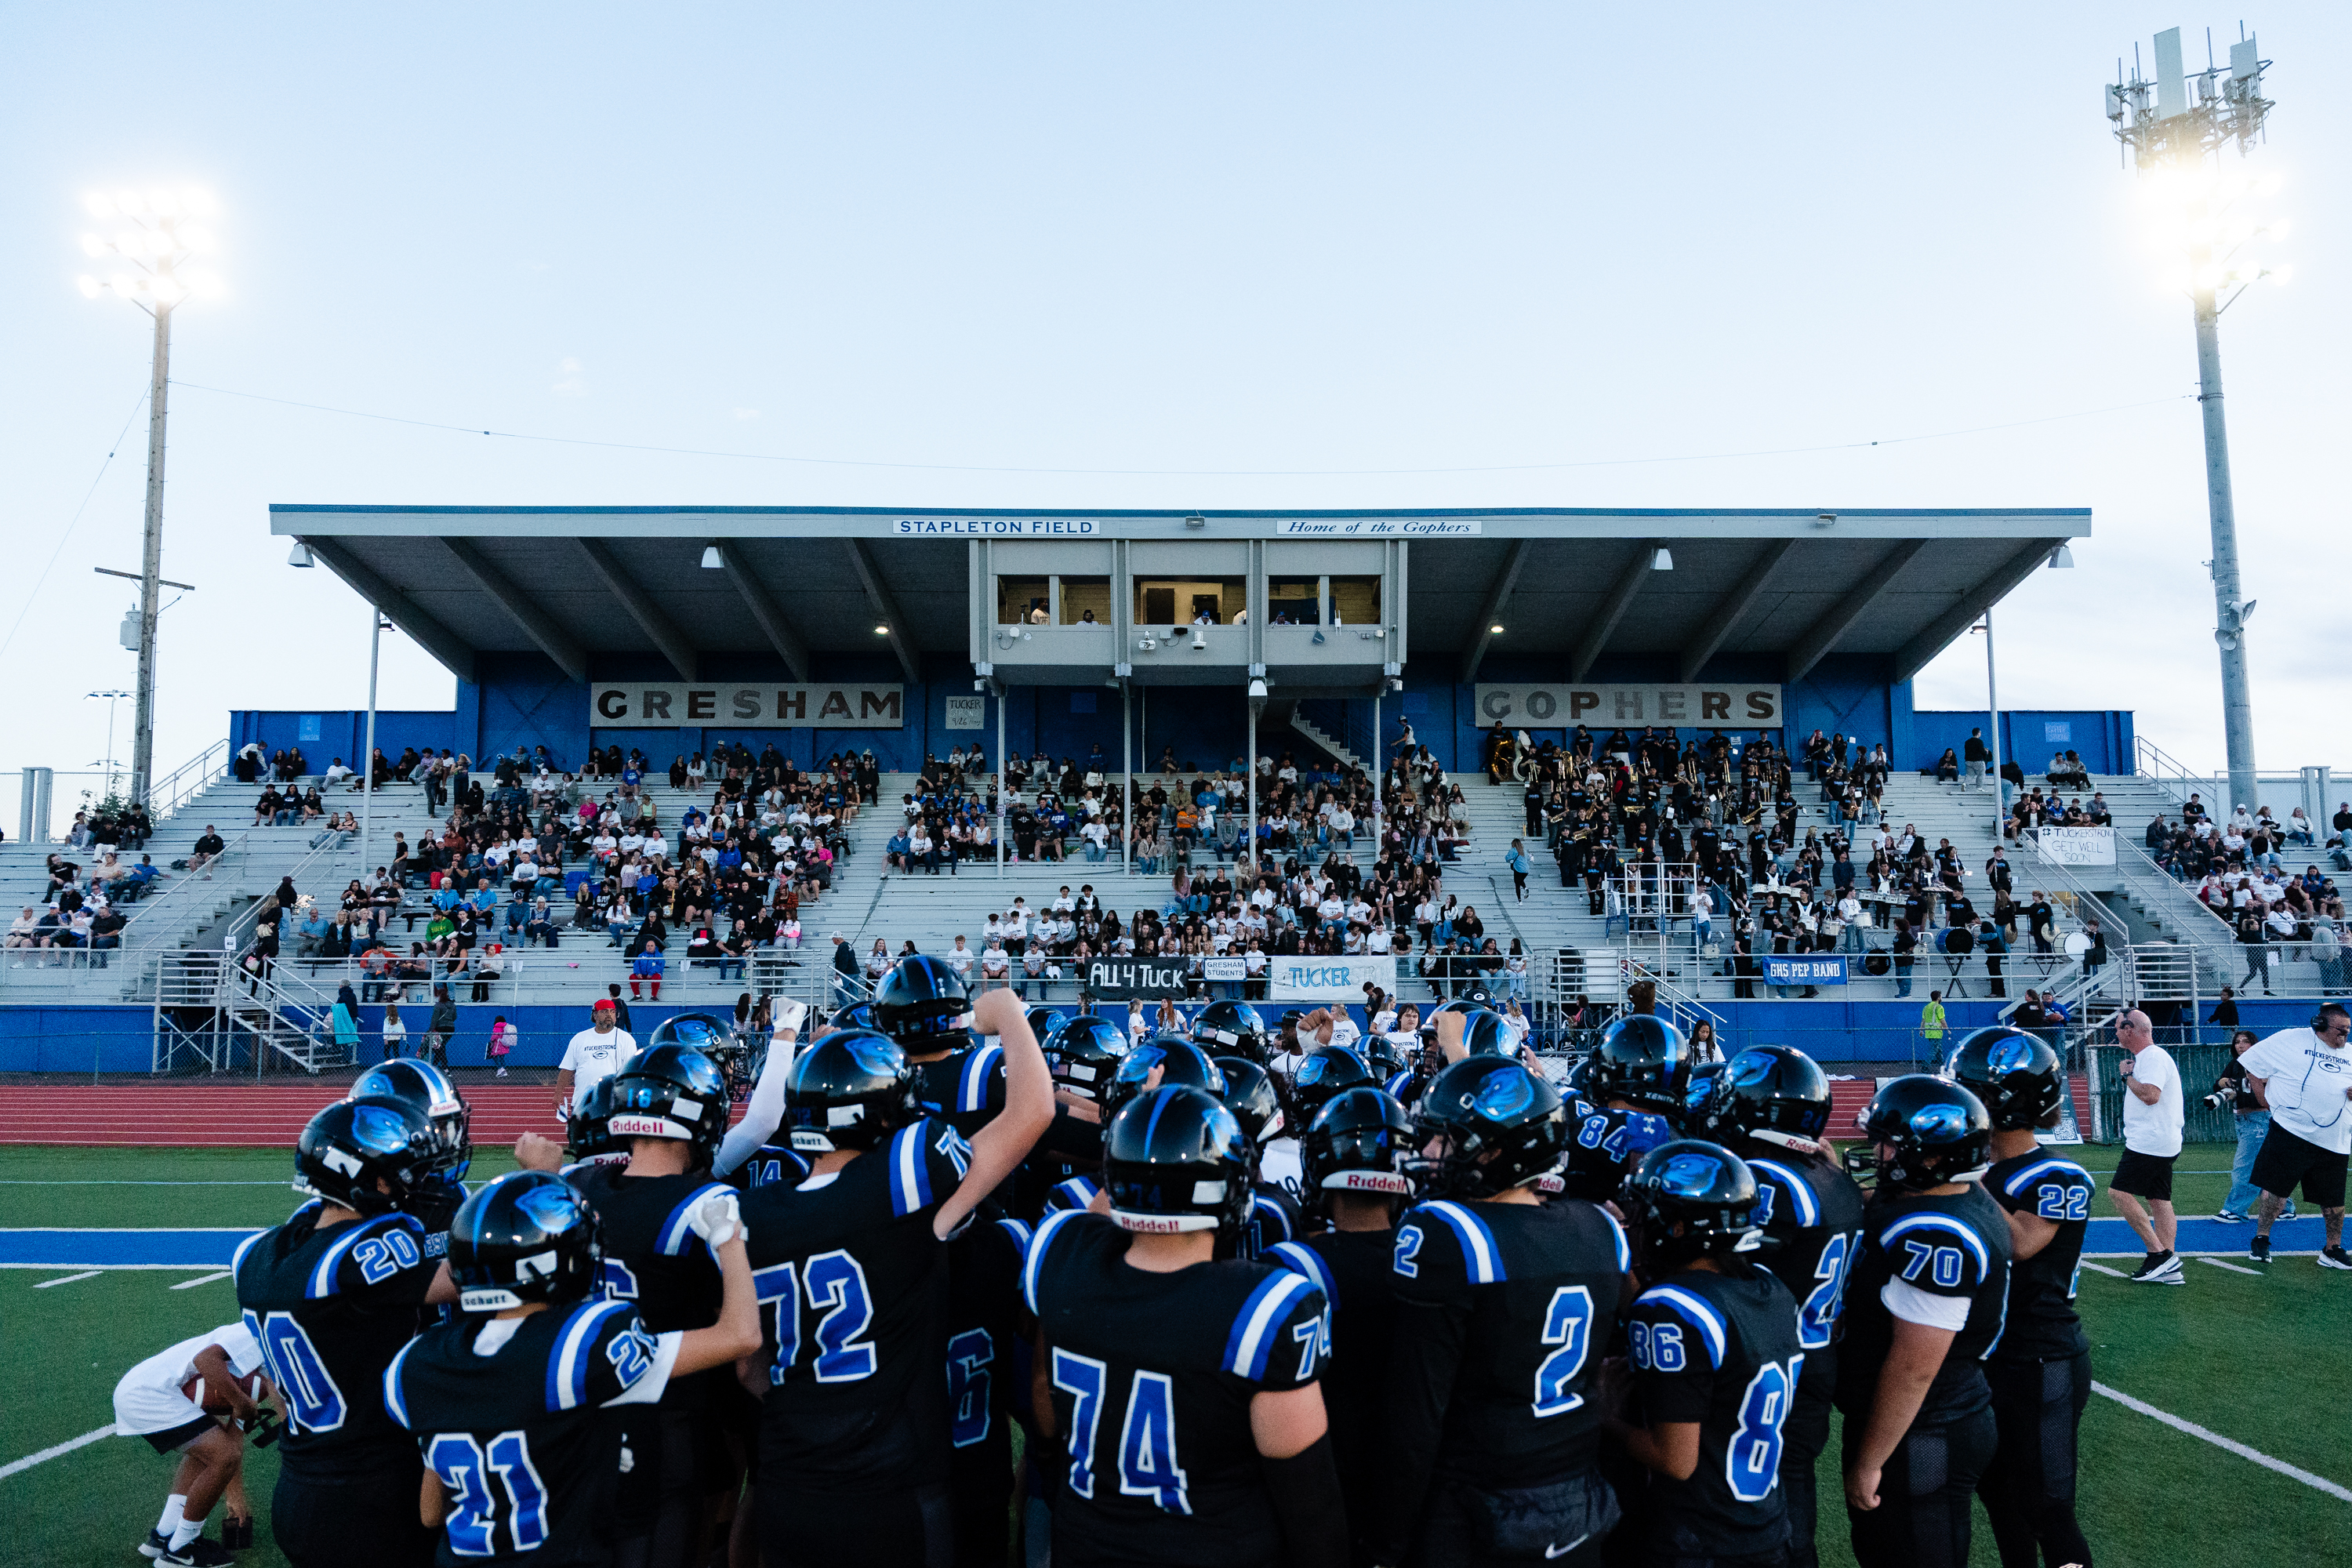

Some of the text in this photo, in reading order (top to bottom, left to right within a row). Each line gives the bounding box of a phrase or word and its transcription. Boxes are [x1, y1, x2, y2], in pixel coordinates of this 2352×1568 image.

[901, 521, 1092, 533] STAPLETON FIELD
[1287, 521, 1472, 534] Home of the Gophers
[597, 689, 902, 720] GRESHAM
[949, 699, 982, 710] TUCKER
[1481, 690, 1775, 720] GOPHERS
[2051, 840, 2103, 853] GET WELL
[2064, 852, 2091, 863] SOON
[1090, 963, 1185, 989] ALL 4 TUCK
[1288, 967, 1352, 988] TUCKER
[1769, 964, 1840, 977] GHS PEP BAND
[924, 1014, 948, 1033] 75
[626, 1087, 652, 1109] 16
[1645, 1091, 1675, 1104] XENITH
[612, 1120, 664, 1134] Riddell
[1577, 1114, 1628, 1164] 84
[1348, 1174, 1406, 1192] Riddell
[2038, 1184, 2089, 1221] 22
[1121, 1217, 1179, 1232] Riddell
[352, 1228, 420, 1286] 20
[1394, 1224, 1424, 1279] 2
[1901, 1240, 1963, 1287] 70
[463, 1294, 506, 1305] schutt
[753, 1248, 879, 1386] 72
[1532, 1285, 1595, 1419] 2
[1628, 1319, 1687, 1371] 86
[1051, 1345, 1194, 1515] 74
